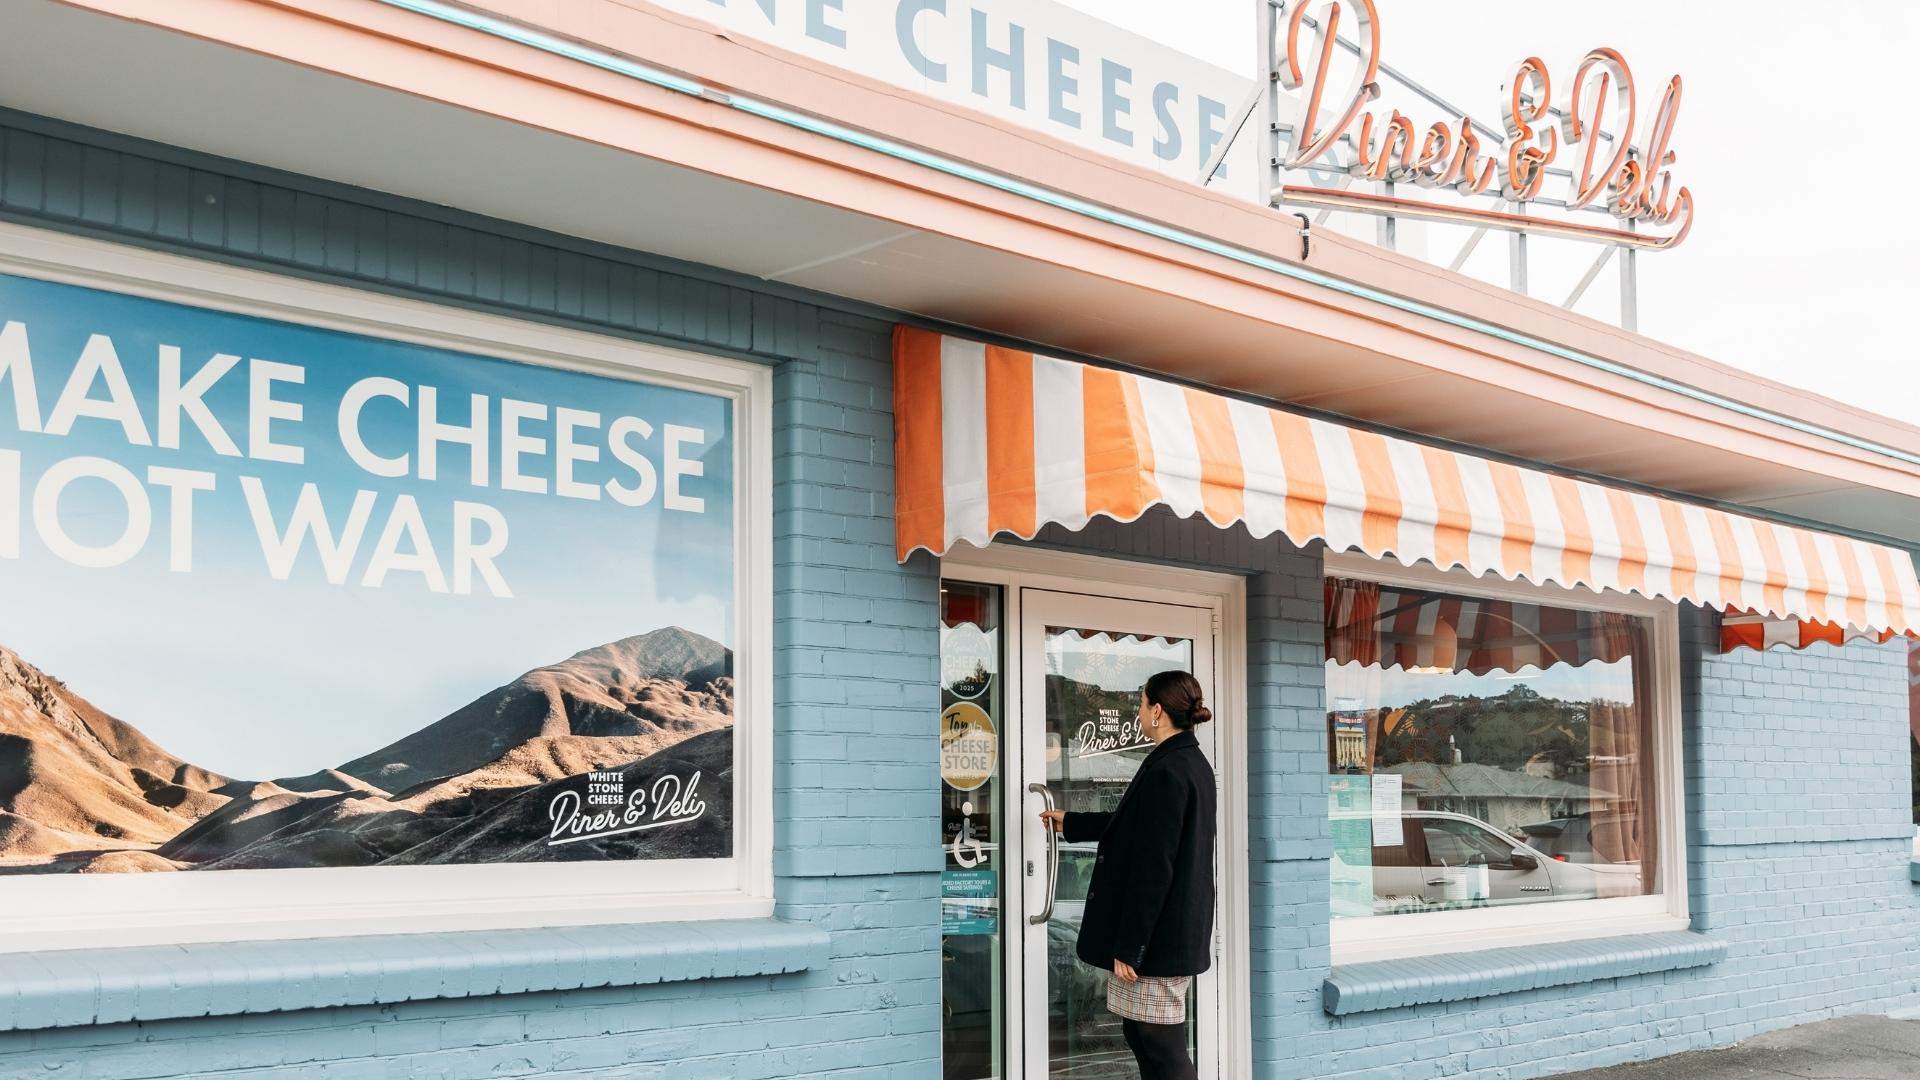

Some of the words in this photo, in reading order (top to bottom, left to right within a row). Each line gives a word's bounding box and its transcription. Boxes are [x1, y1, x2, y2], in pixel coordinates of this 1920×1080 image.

[895, 0, 1228, 180] CHEESE
[1274, 0, 1496, 197] Diner
[1501, 56, 1557, 202] &
[1560, 46, 1693, 228] Deli
[338, 376, 705, 514] CHEESE
[0, 449, 216, 573] OT
[239, 475, 515, 598] WAR
[1099, 709, 1120, 717] WHITE
[942, 739, 990, 754] CHEESE
[1079, 721, 1118, 753] Diner
[1120, 721, 1132, 746] &
[944, 755, 987, 770] STORE
[588, 772, 624, 782] WHITE
[588, 783, 624, 793] STONE
[549, 790, 621, 839] Diner
[624, 788, 646, 825] &
[651, 770, 704, 821] Deli
[588, 794, 624, 805] CHEESE
